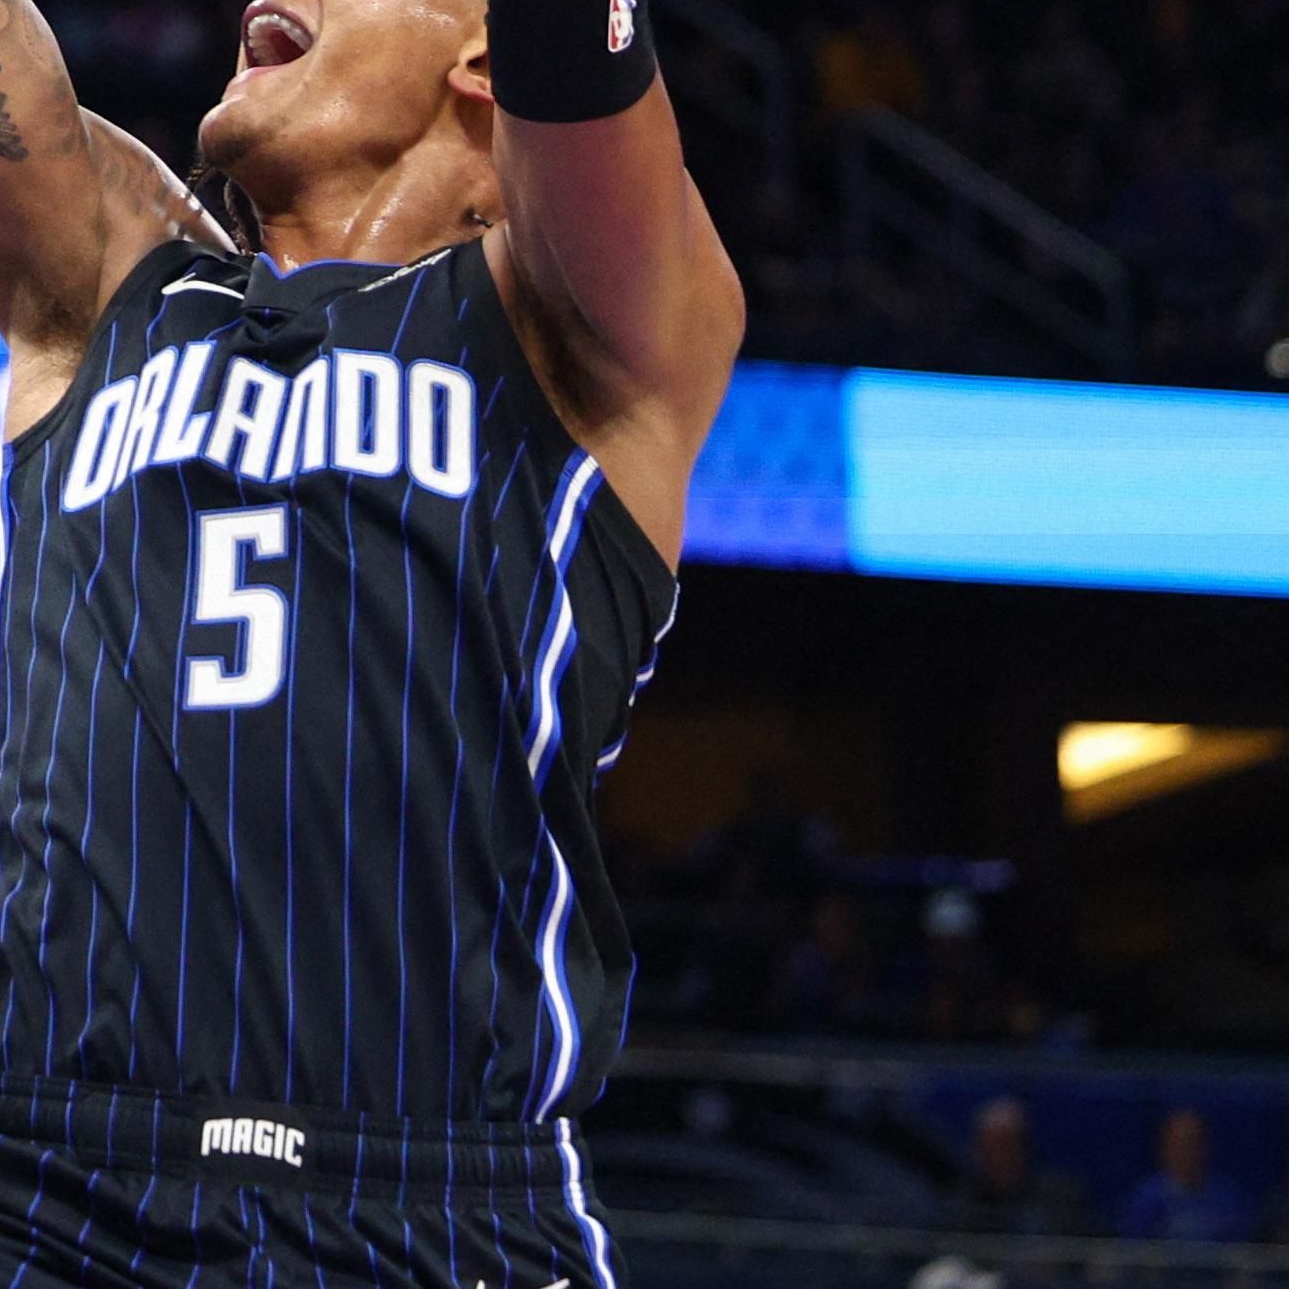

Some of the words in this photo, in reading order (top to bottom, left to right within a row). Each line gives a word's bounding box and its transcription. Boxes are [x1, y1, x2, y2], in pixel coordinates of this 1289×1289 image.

[60, 340, 478, 513] ORLANDO
[183, 501, 289, 711] 5
[200, 1118, 306, 1167] MAGIC
